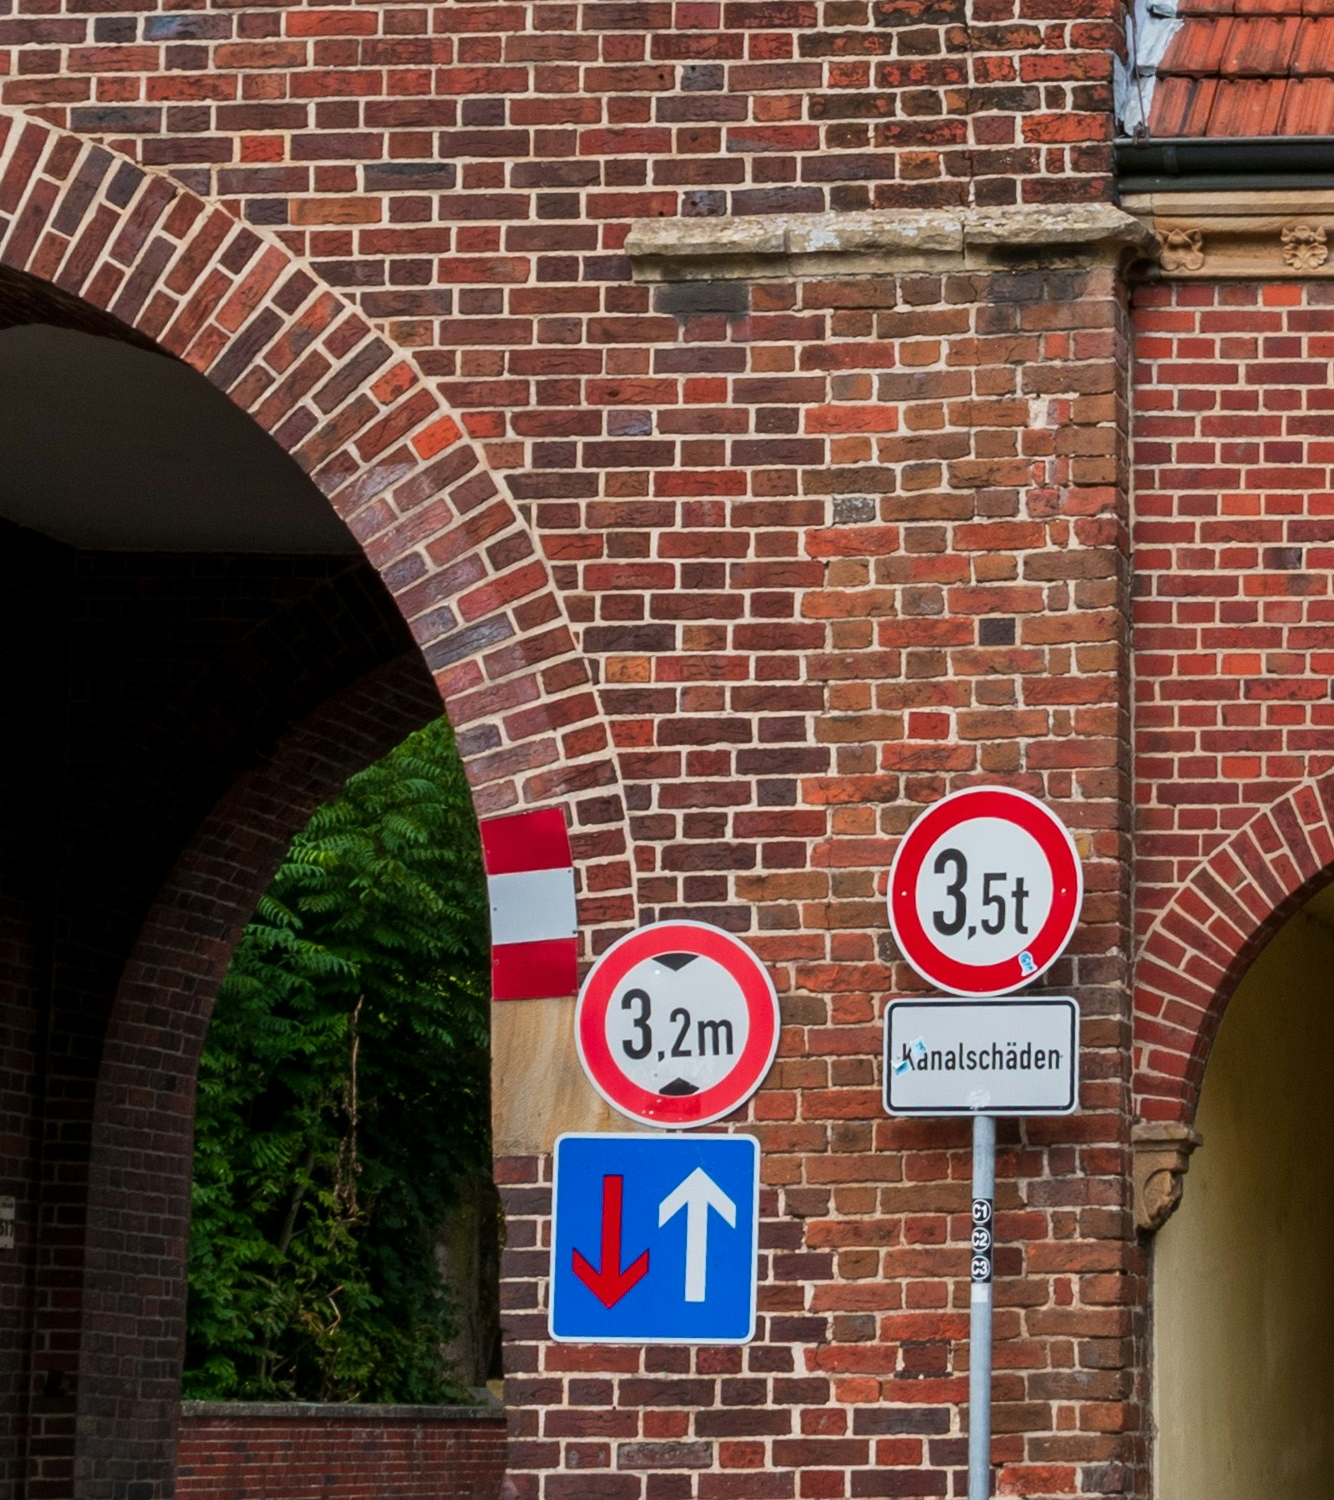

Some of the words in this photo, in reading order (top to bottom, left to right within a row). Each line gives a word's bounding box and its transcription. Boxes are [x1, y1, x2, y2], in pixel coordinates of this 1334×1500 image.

[902, 1042, 1060, 1071] Kanalschäden
[972, 1203, 987, 1219] C1
[972, 1232, 987, 1247] C2
[971, 1260, 987, 1275] C3
